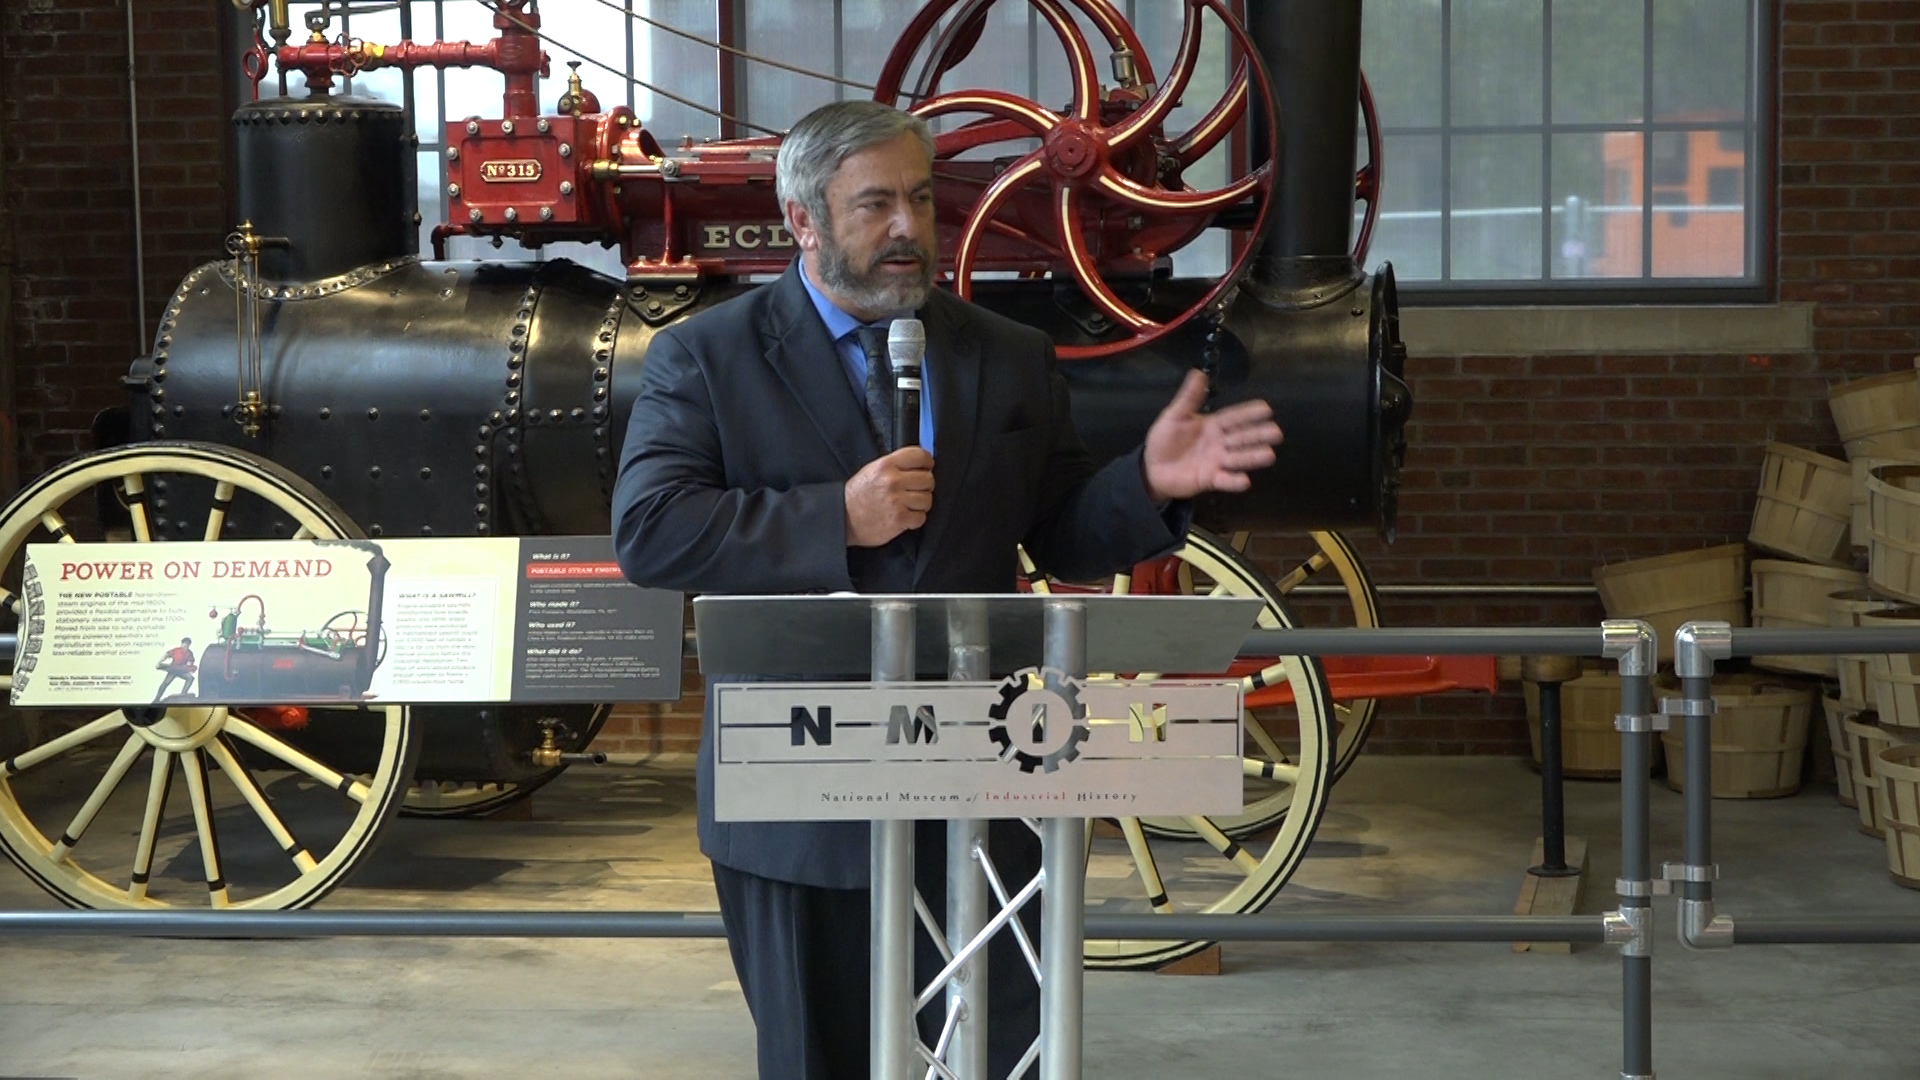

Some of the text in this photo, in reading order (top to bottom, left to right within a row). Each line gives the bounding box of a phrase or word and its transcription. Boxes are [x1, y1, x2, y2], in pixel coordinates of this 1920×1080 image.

[507, 164, 535, 177] 315
[60, 559, 333, 580] POWER ON DEMAND
[821, 792, 889, 802] National
[899, 792, 960, 802] Museum
[986, 791, 1067, 801] Industrial
[1077, 793, 1137, 803] History
